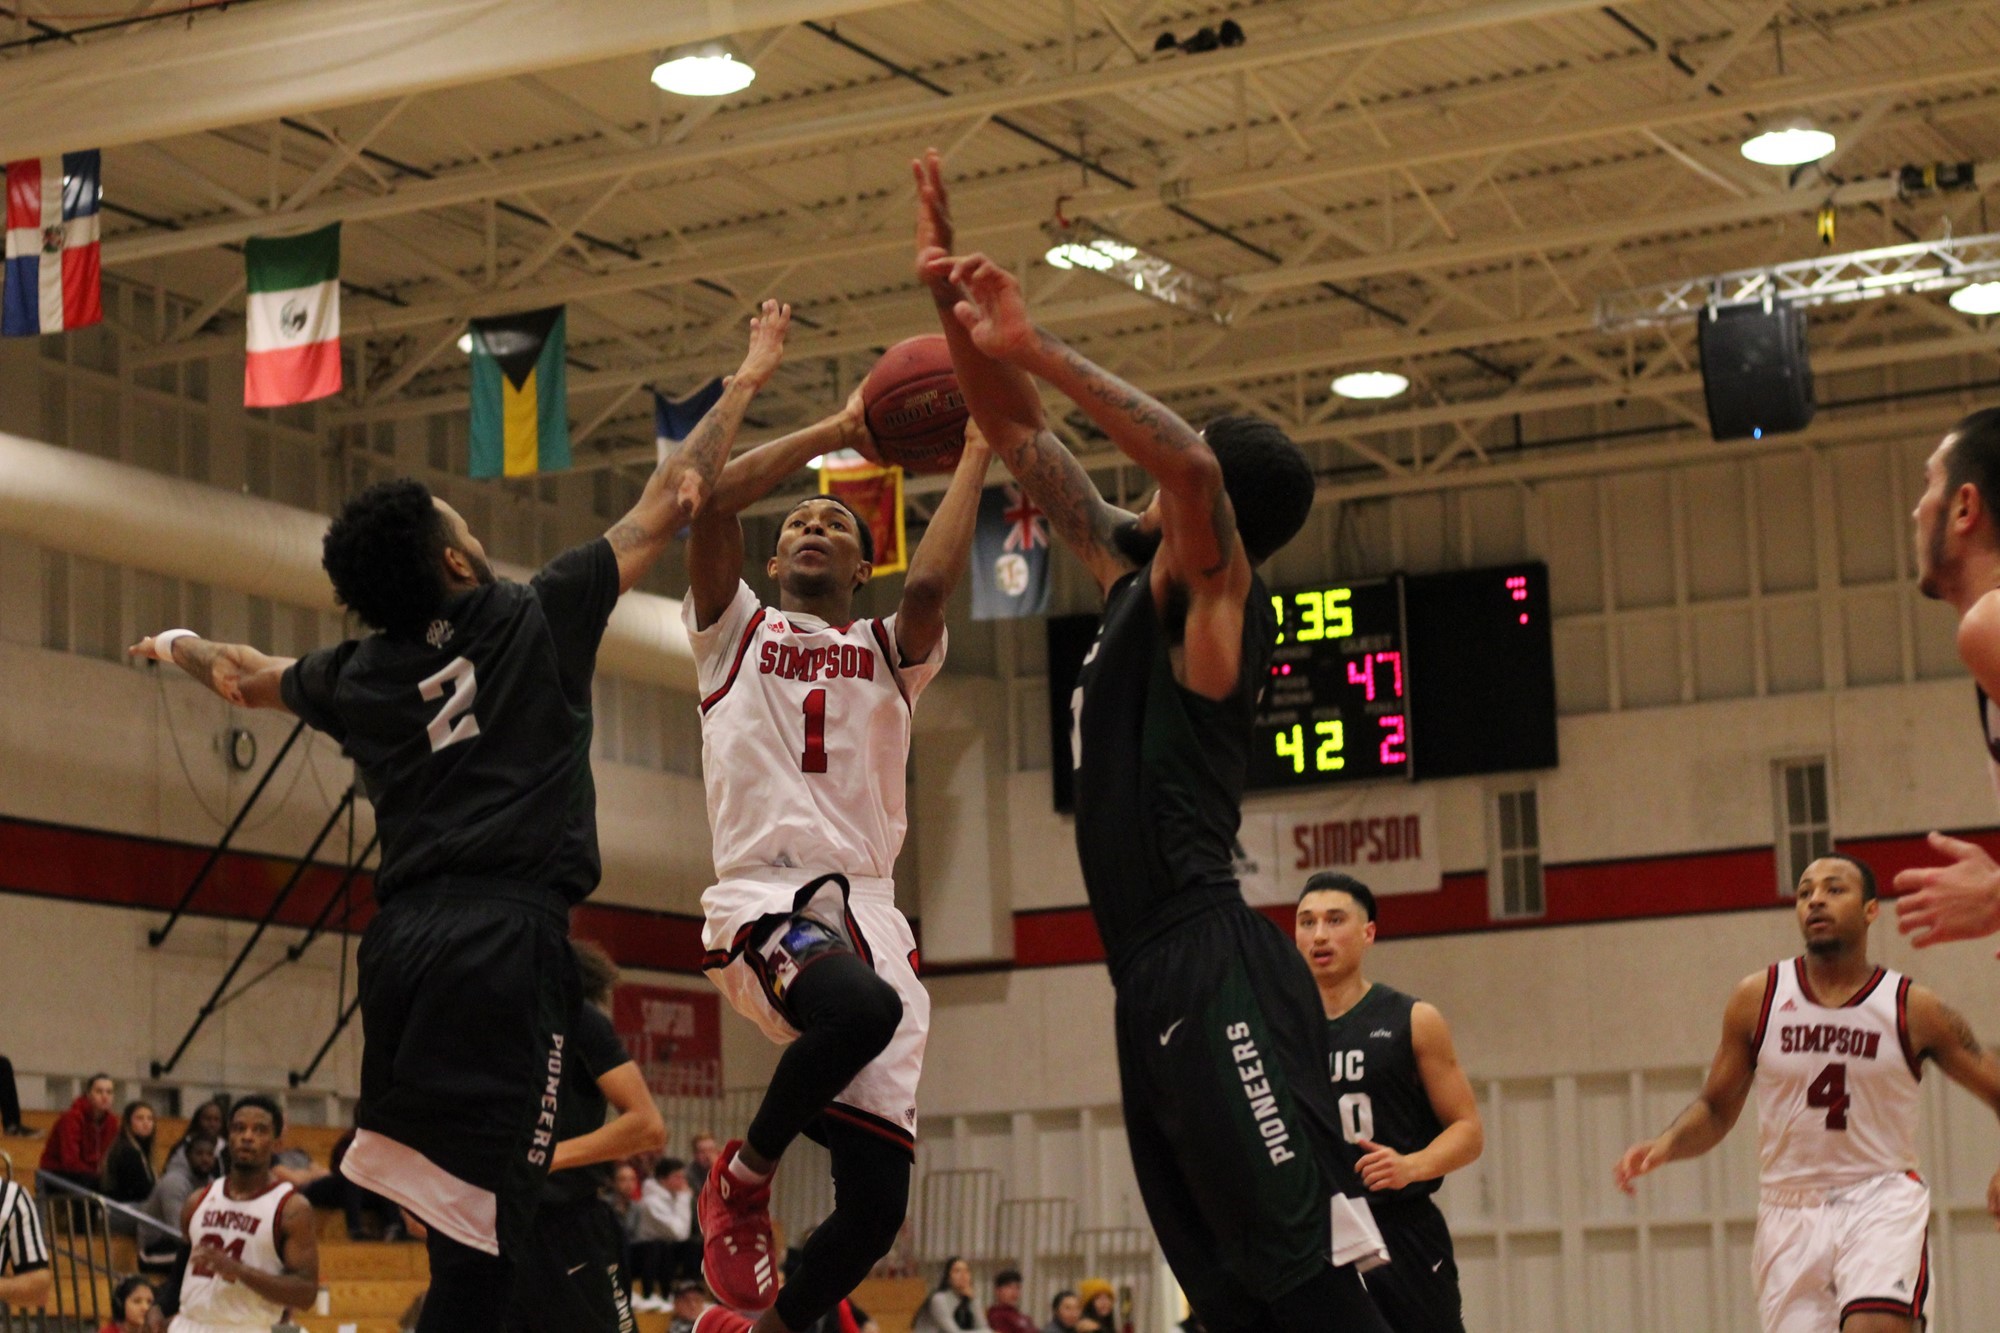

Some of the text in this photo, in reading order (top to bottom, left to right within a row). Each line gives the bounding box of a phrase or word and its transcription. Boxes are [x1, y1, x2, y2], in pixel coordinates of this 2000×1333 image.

[759, 640, 875, 682] SIMPSON
[1347, 651, 1402, 701] 47
[417, 655, 481, 753] 2
[801, 688, 828, 774] 1
[1377, 714, 1407, 765] 2
[1294, 813, 1422, 870] SIMPSON
[1781, 1024, 1883, 1060] SIMPSON
[527, 1033, 564, 1167] PIONEERS
[1226, 1020, 1296, 1167] PIONEERS
[1807, 1062, 1850, 1131] 4
[201, 1209, 262, 1236] SIMPSON
